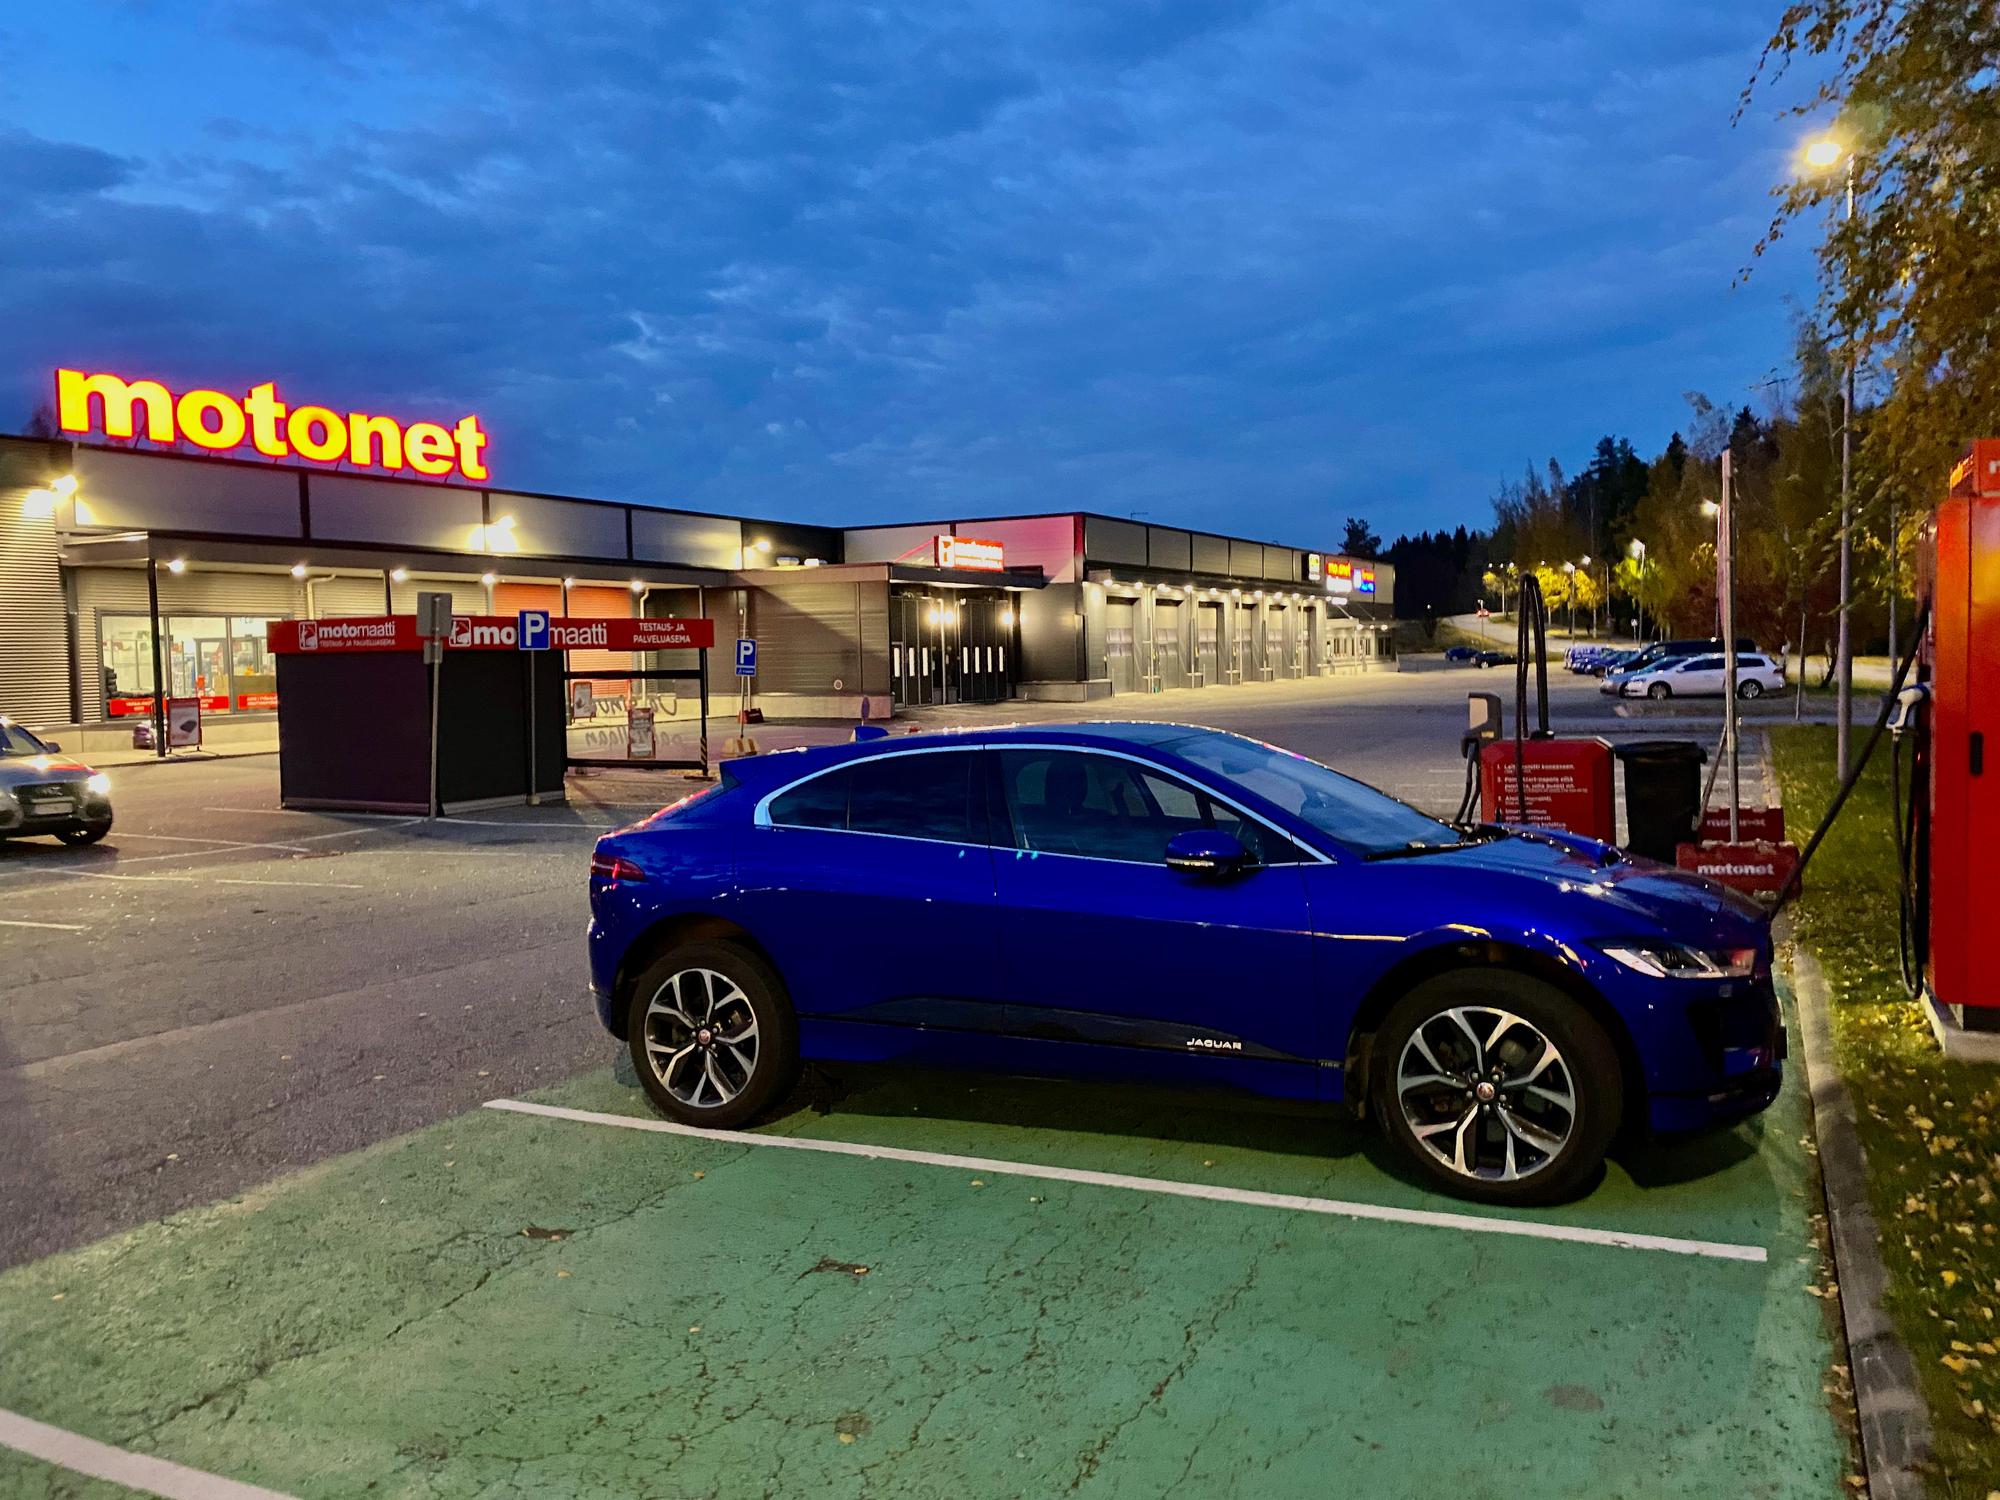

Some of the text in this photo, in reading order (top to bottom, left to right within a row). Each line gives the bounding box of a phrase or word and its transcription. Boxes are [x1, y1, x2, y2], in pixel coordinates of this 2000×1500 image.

[57, 367, 488, 481] motonet
[319, 621, 396, 638] motomaatti
[473, 622, 608, 645] momaatti
[525, 612, 545, 647] P
[740, 641, 754, 665] P
[1186, 1037, 1242, 1050] JAGUAR
